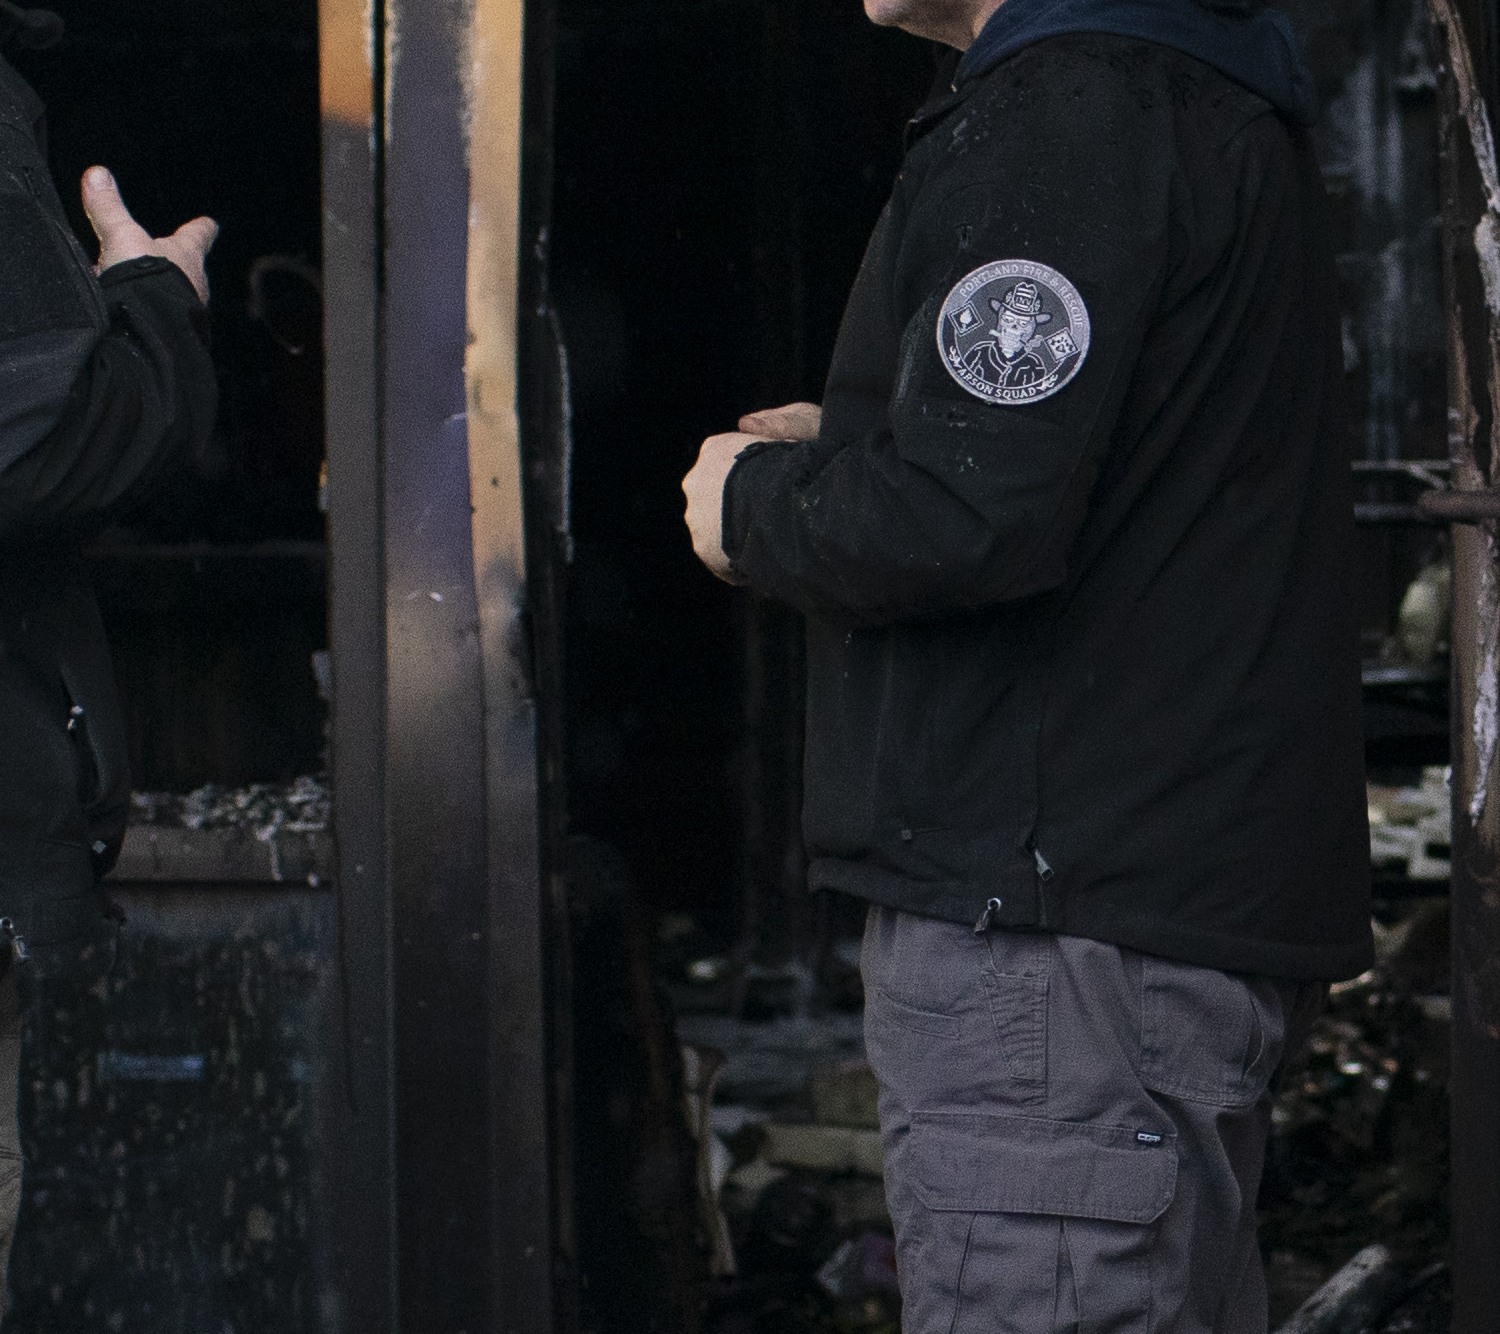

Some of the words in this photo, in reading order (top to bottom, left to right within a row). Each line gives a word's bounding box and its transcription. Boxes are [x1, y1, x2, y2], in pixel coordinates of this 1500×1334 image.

[960, 264, 1019, 297] PORTLAND
[1023, 265, 1050, 280] FIRE
[1058, 286, 1084, 329] RESCUE
[958, 367, 994, 395] ARSON
[994, 386, 1037, 401] SQUAD
